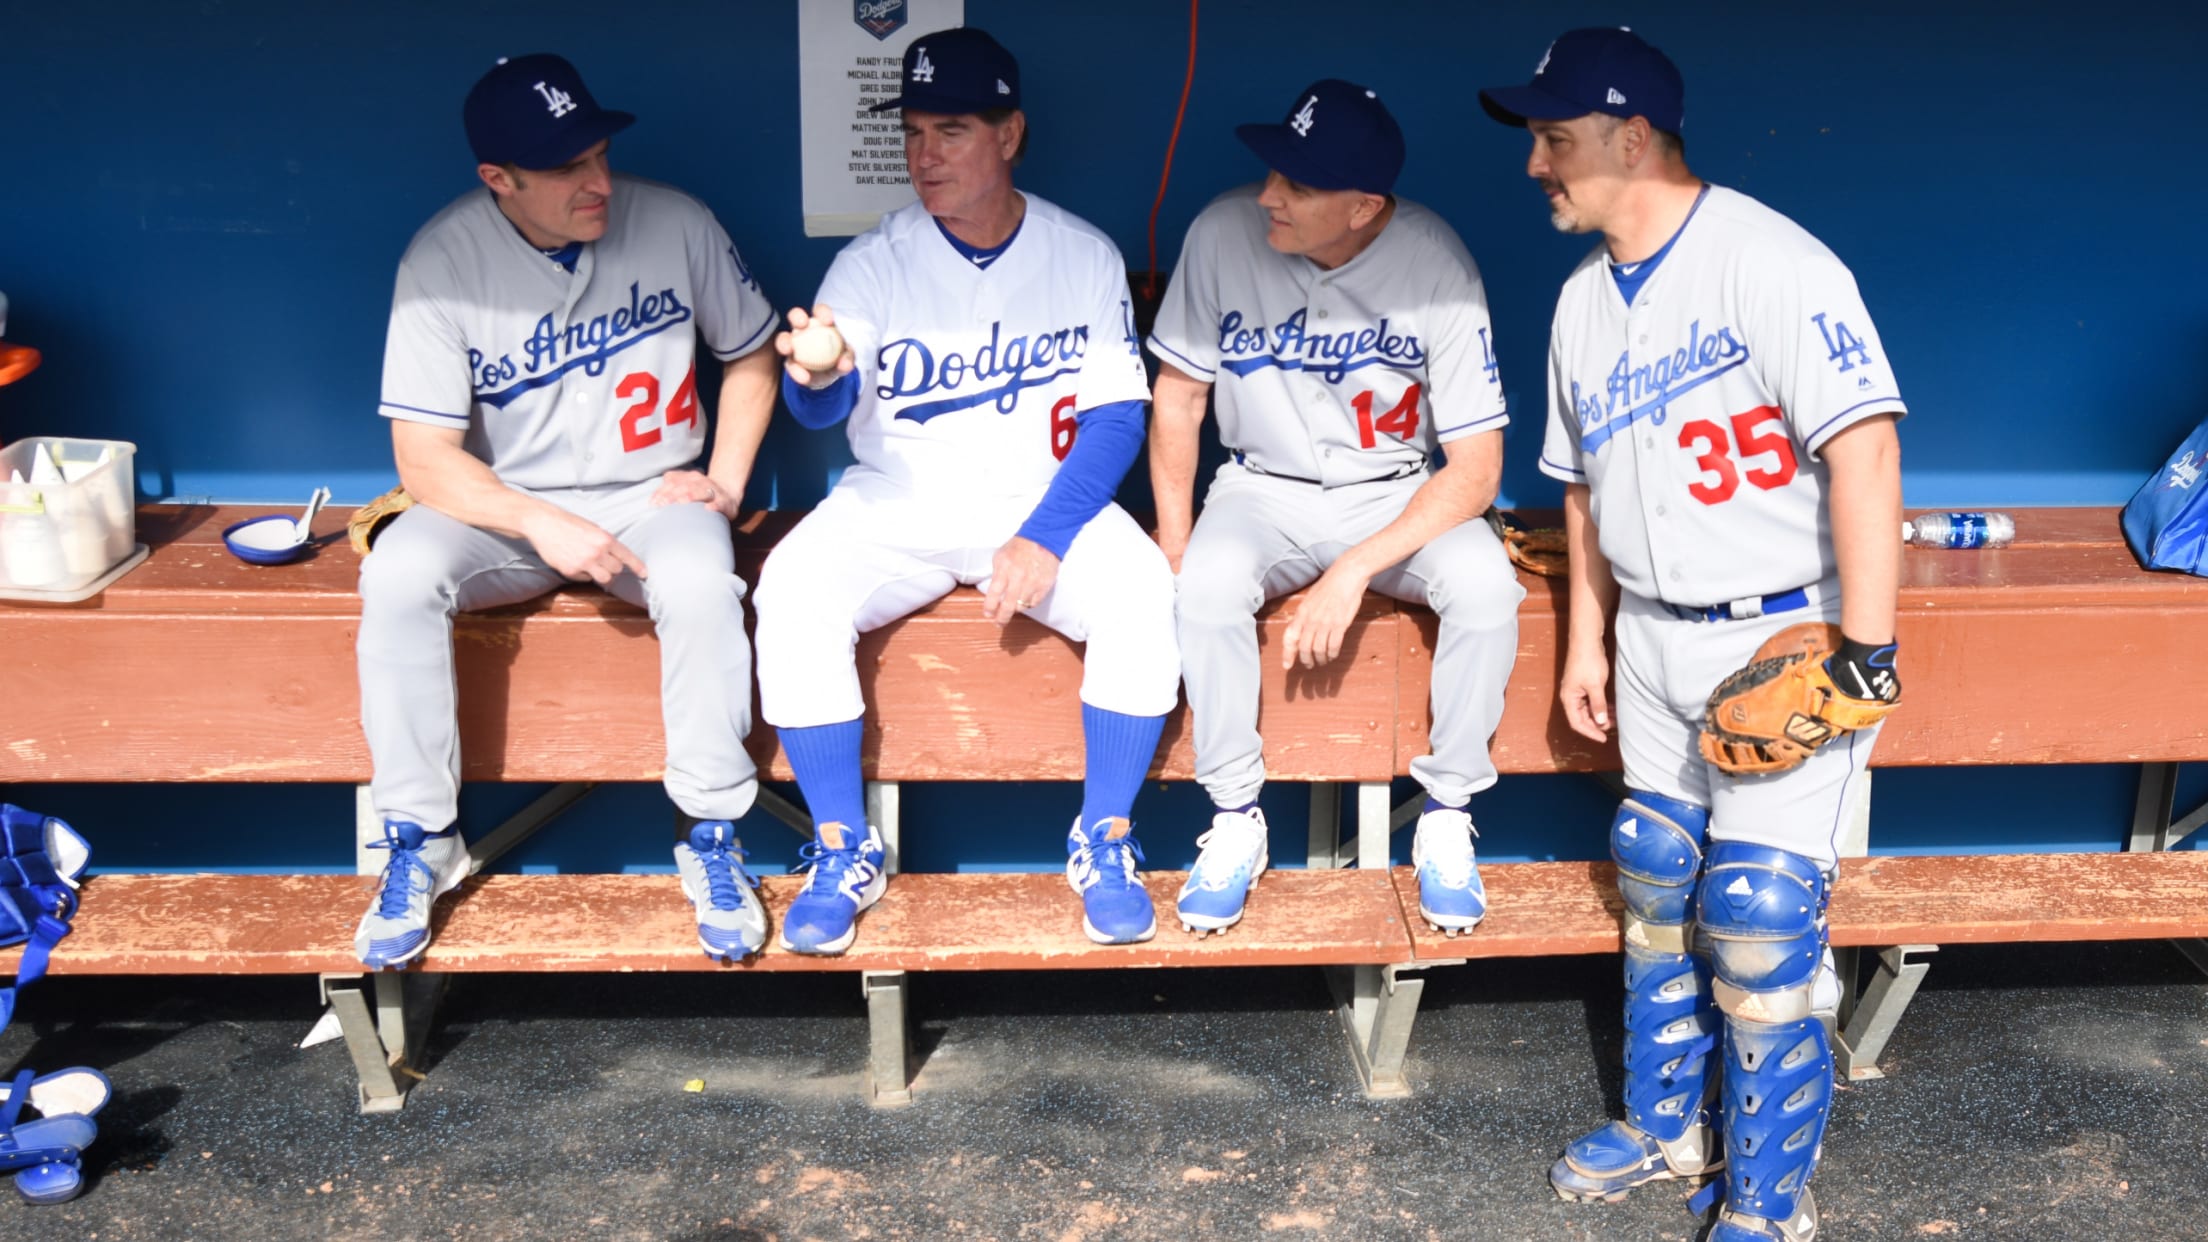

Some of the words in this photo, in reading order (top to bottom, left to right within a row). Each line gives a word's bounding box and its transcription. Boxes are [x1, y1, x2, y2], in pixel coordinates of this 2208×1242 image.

[848, 70, 879, 80] MICHAEL
[857, 57, 881, 67] RANDY
[912, 47, 935, 82] LA
[533, 80, 577, 118] LA
[858, 97, 877, 106] JOHN
[860, 83, 879, 93] GREG
[852, 123, 889, 133] MATTHEW
[856, 110, 878, 120] DREW
[1291, 95, 1319, 137] LA
[851, 150, 867, 159] MAT
[863, 136, 882, 146] DOUG
[849, 162, 871, 172] STEVE
[856, 175, 875, 185] DAVE
[469, 348, 517, 389] Los
[524, 280, 693, 377] Angeles
[1219, 310, 1266, 354] Los
[1271, 307, 1425, 384] Angeles
[1811, 312, 1872, 373] LA
[877, 321, 1089, 415] Dodgers
[1606, 319, 1749, 426] Angeles
[615, 360, 699, 453] 24
[1351, 382, 1421, 449] 14
[1051, 392, 1078, 463] 6
[1678, 405, 1799, 506] 35
